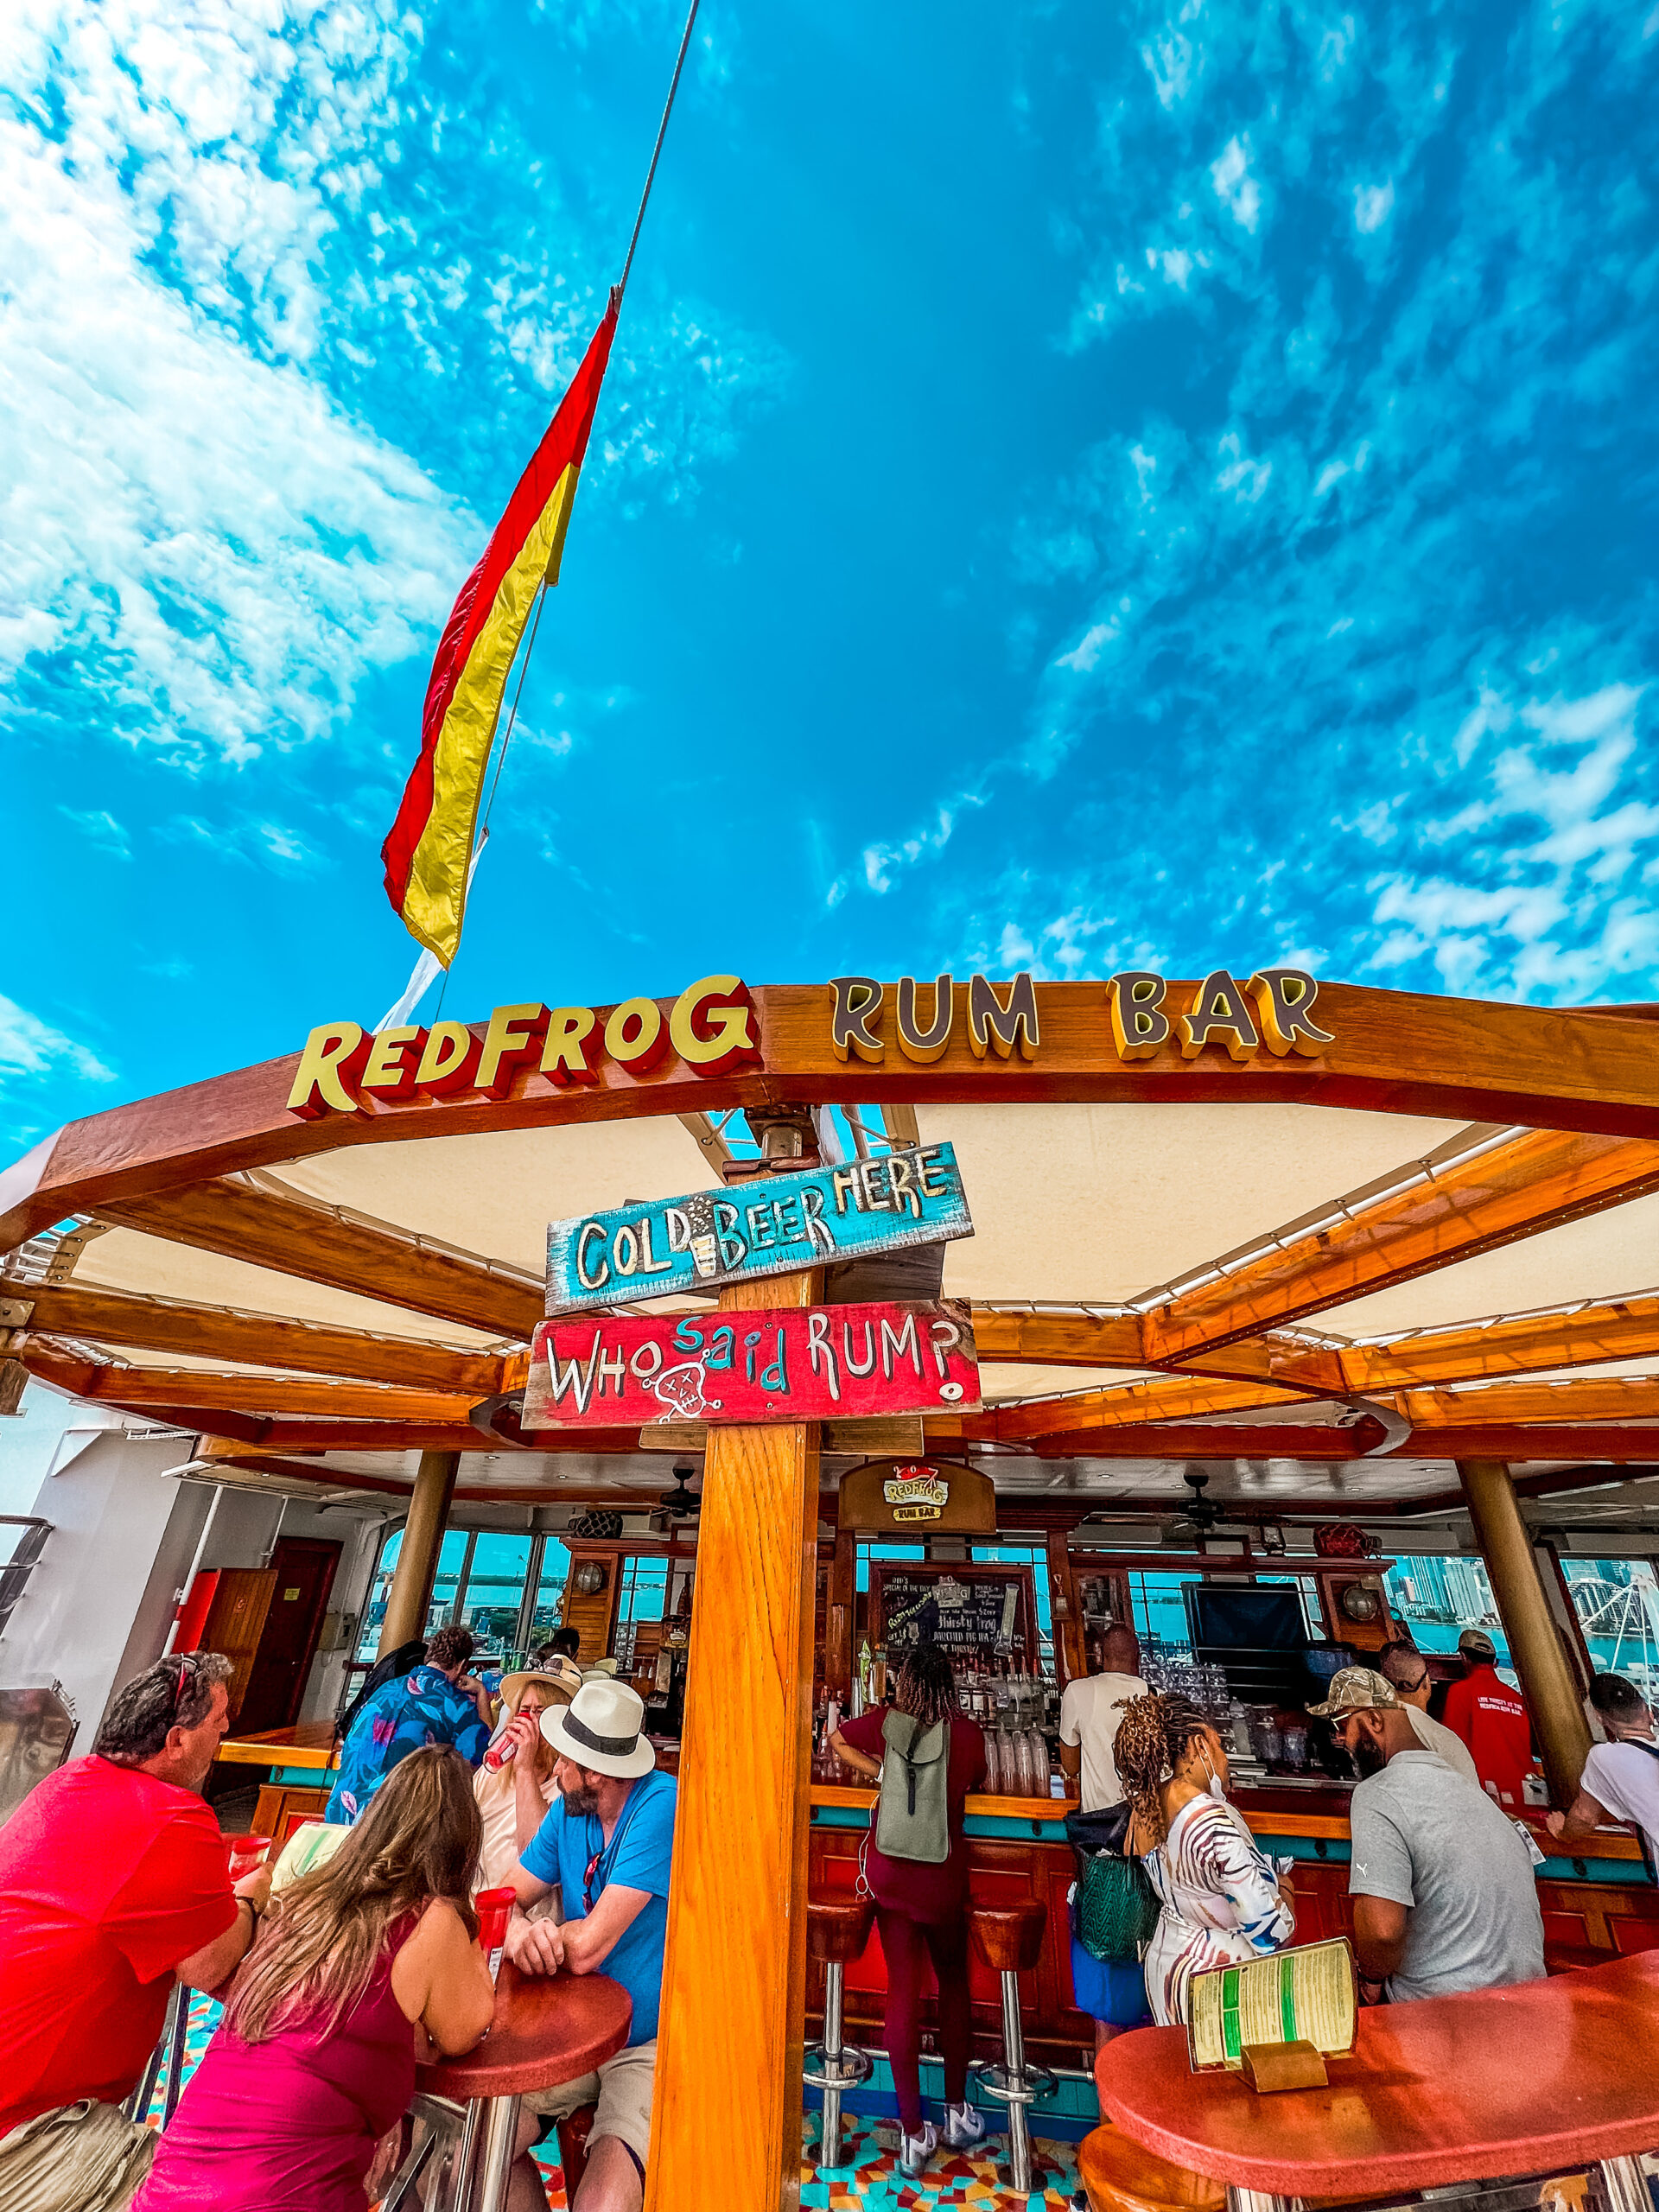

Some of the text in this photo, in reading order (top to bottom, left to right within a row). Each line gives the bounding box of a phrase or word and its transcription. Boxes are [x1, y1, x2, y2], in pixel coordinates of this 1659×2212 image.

[286, 969, 1336, 1115] REDFROG RUM BAR
[577, 1149, 948, 1290] COLD BEER HERE
[546, 1329, 663, 1414] WHO
